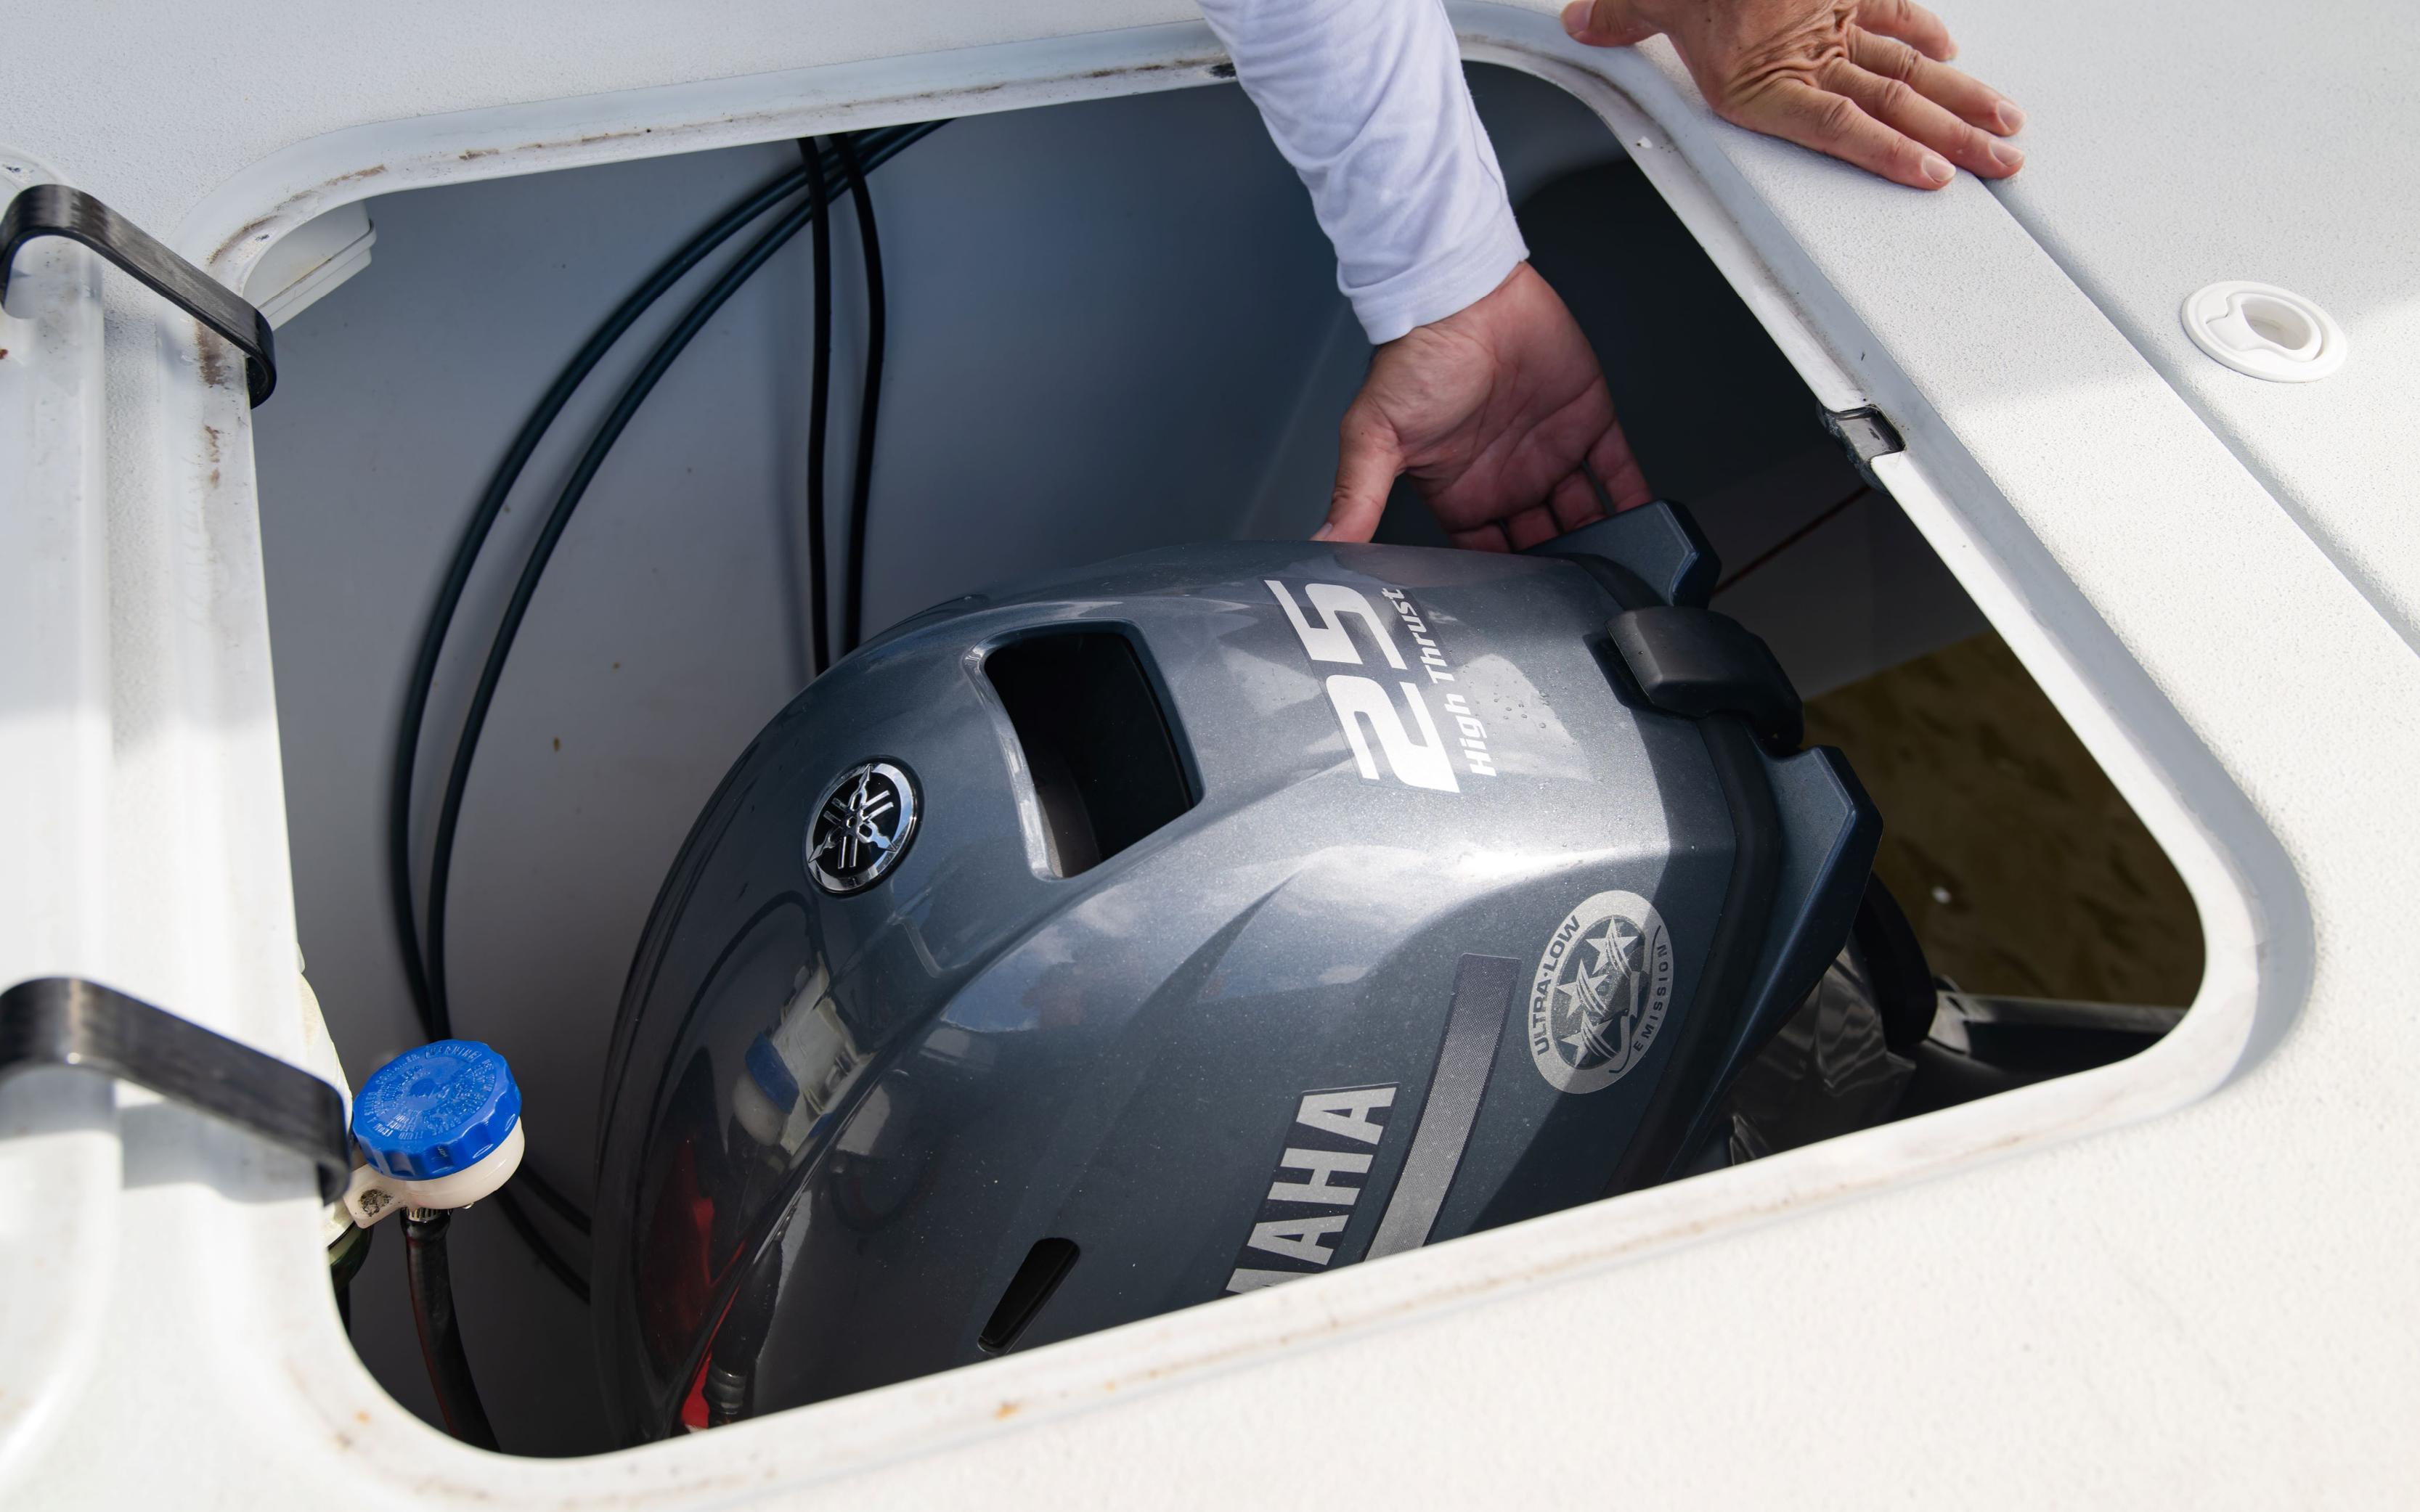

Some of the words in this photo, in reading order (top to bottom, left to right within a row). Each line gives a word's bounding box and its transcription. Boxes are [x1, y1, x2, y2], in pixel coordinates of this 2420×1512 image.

[1264, 580, 1460, 793] 25
[1381, 588, 1455, 684] Thrust
[1443, 693, 1496, 777] High
[1632, 944, 1669, 1053] EMISSION
